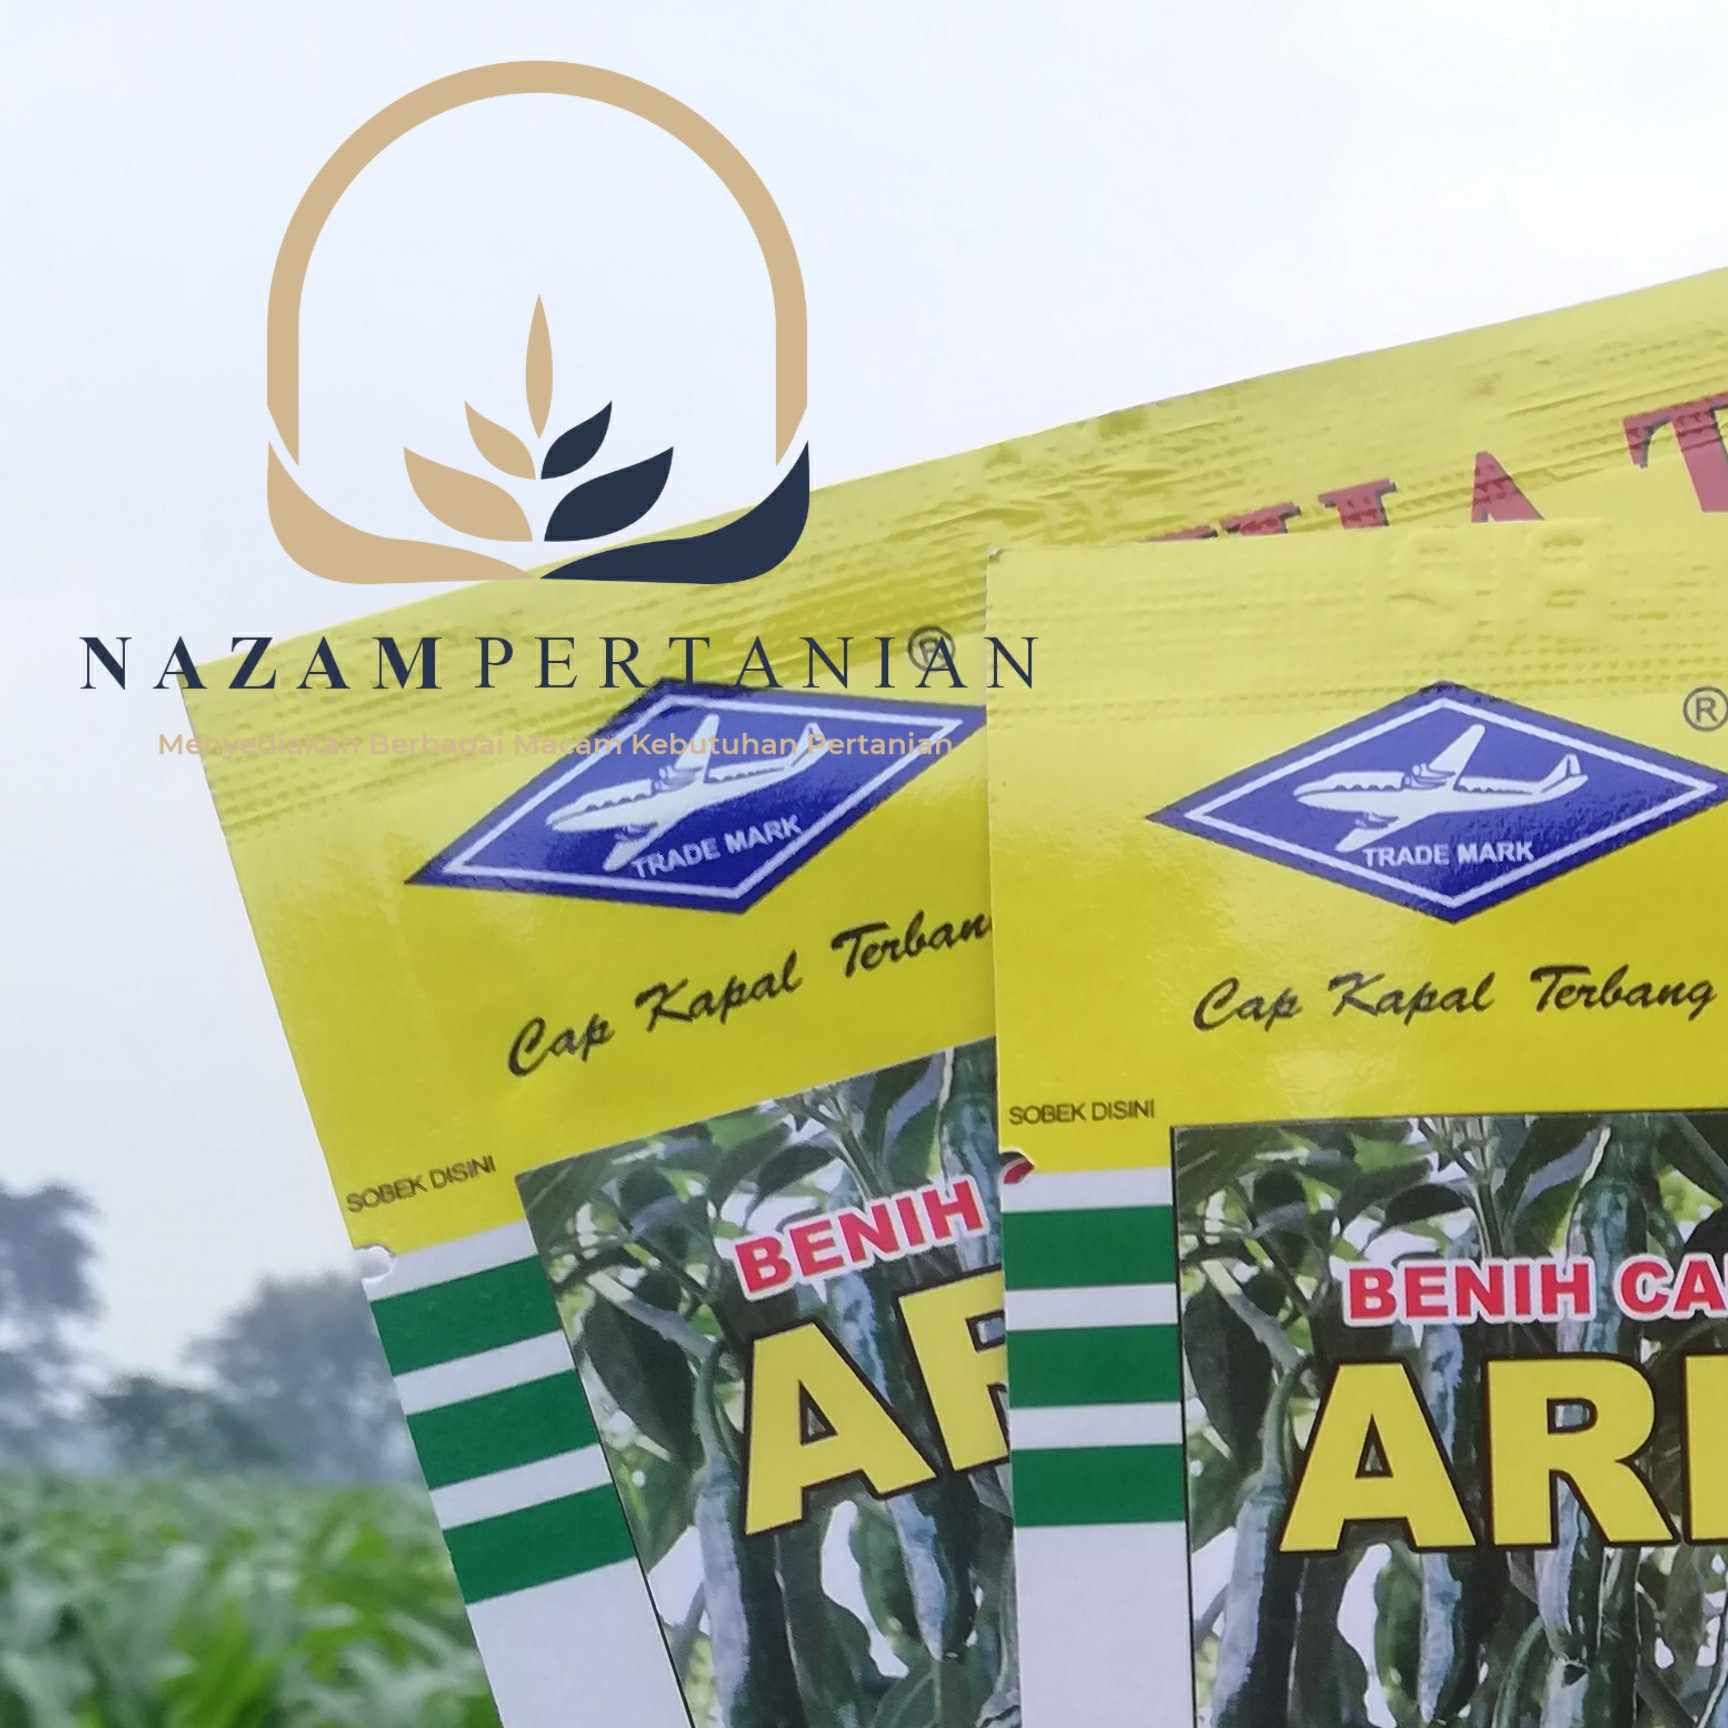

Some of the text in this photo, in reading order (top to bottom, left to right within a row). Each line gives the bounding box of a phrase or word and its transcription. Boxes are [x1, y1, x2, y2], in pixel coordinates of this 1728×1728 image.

[631, 814, 802, 880] TRADE MARK
[1363, 840, 1535, 868] TRADE MARK
[507, 909, 993, 1078] Cap Kapal Terban
[1193, 965, 1719, 1031] Cap Kapal Terbang
[1008, 1098, 1155, 1126] SOBEK DISINI
[346, 1154, 497, 1214] SOBEK DISINI
[735, 1180, 990, 1300] BENIH
[1344, 1257, 1596, 1325] BENIH
